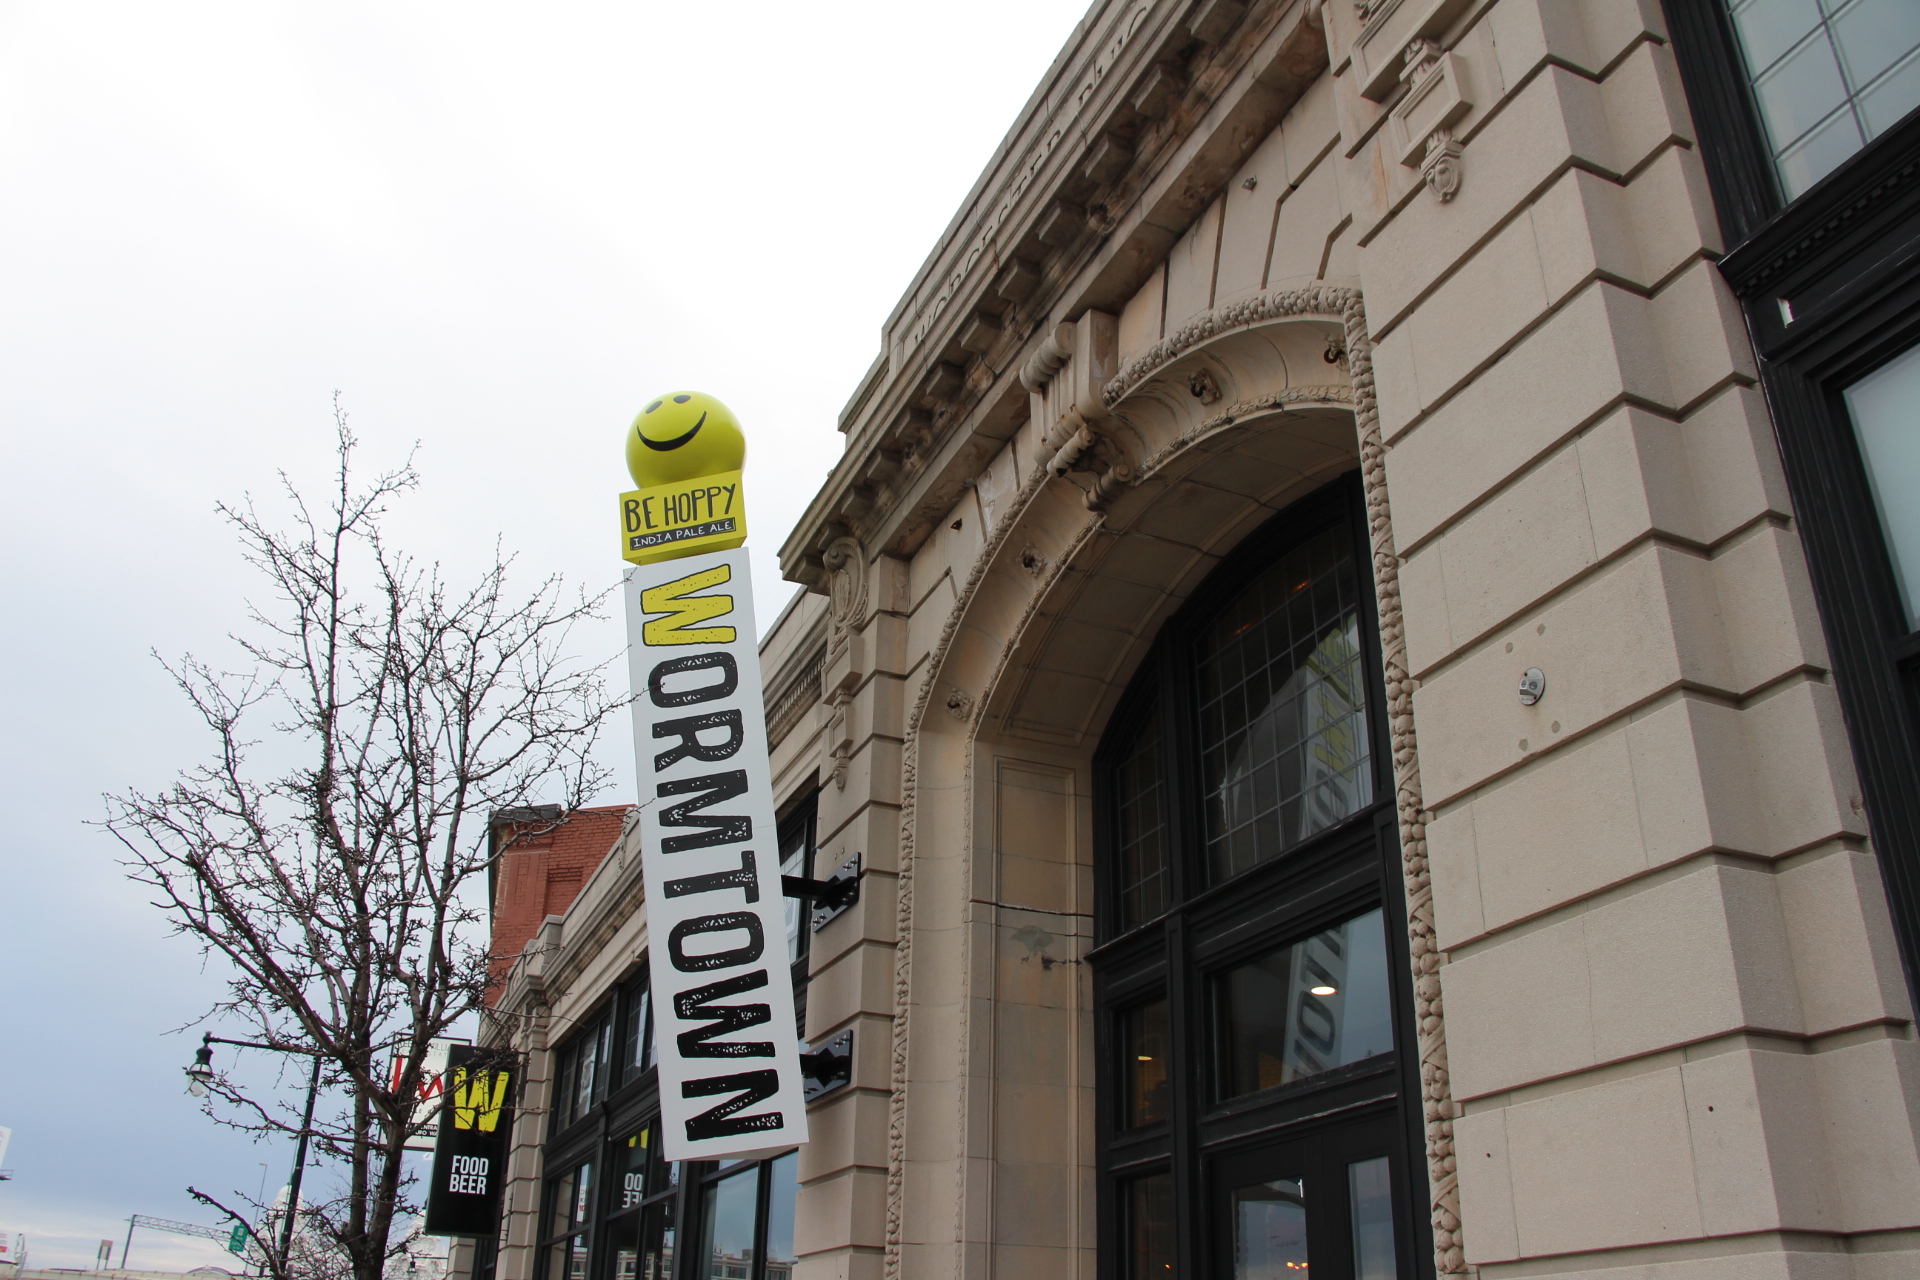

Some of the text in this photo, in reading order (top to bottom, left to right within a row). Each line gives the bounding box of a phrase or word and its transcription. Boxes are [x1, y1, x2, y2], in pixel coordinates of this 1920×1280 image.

[624, 483, 736, 533] BE HOPPY
[633, 520, 732, 548] INDIA PALE ALE
[640, 563, 784, 1142] WORMTOWN
[454, 1066, 509, 1132] W
[449, 1175, 487, 1195] BEER
[451, 1155, 489, 1177] FOOD
